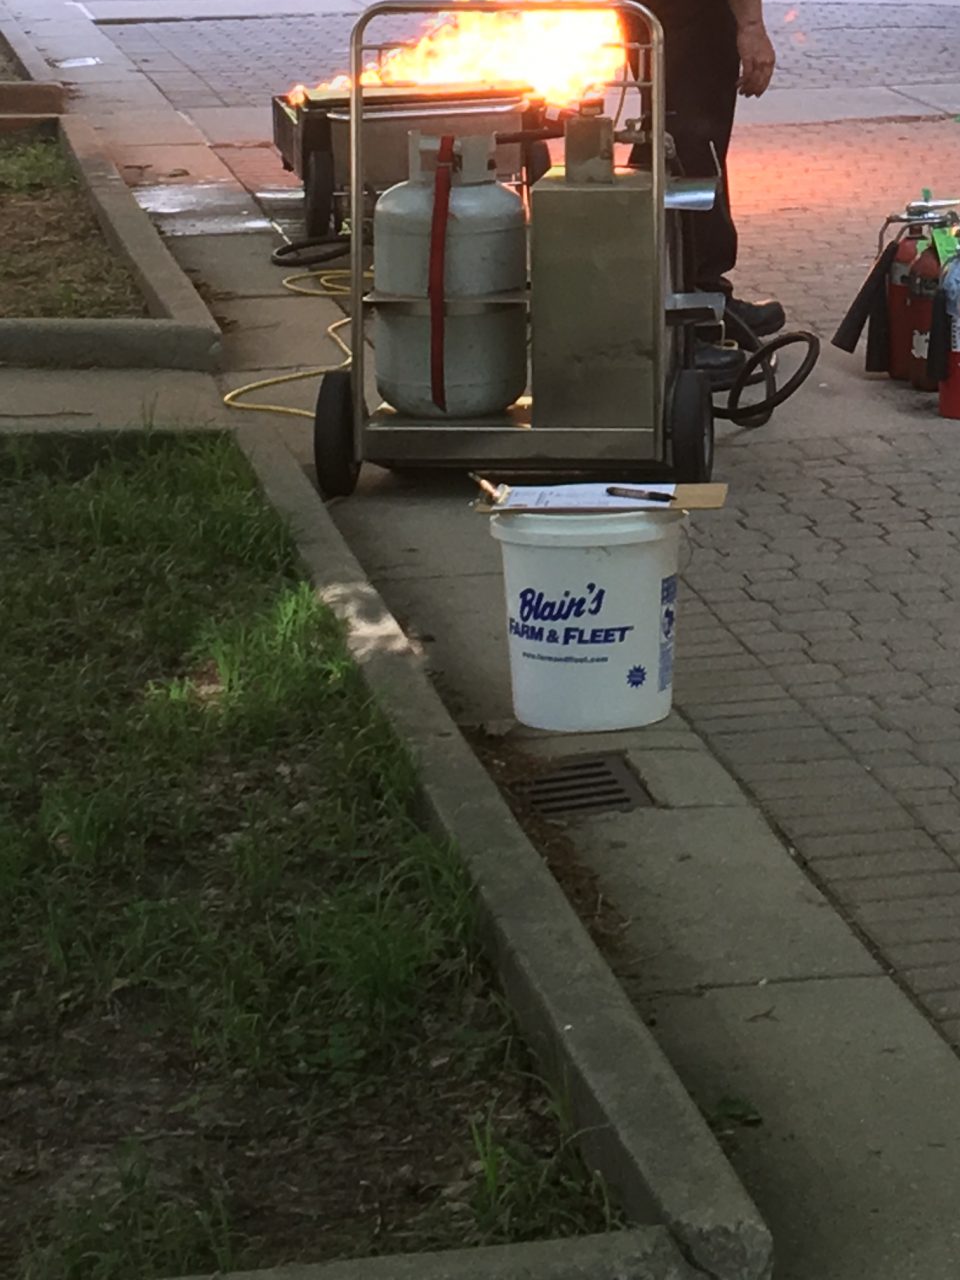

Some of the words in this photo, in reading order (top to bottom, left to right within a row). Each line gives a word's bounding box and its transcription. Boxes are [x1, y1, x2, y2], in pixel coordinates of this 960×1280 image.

[519, 582, 605, 622] Blain's
[509, 618, 544, 642] FARM
[546, 628, 559, 643] &
[562, 625, 632, 645] FLEET
